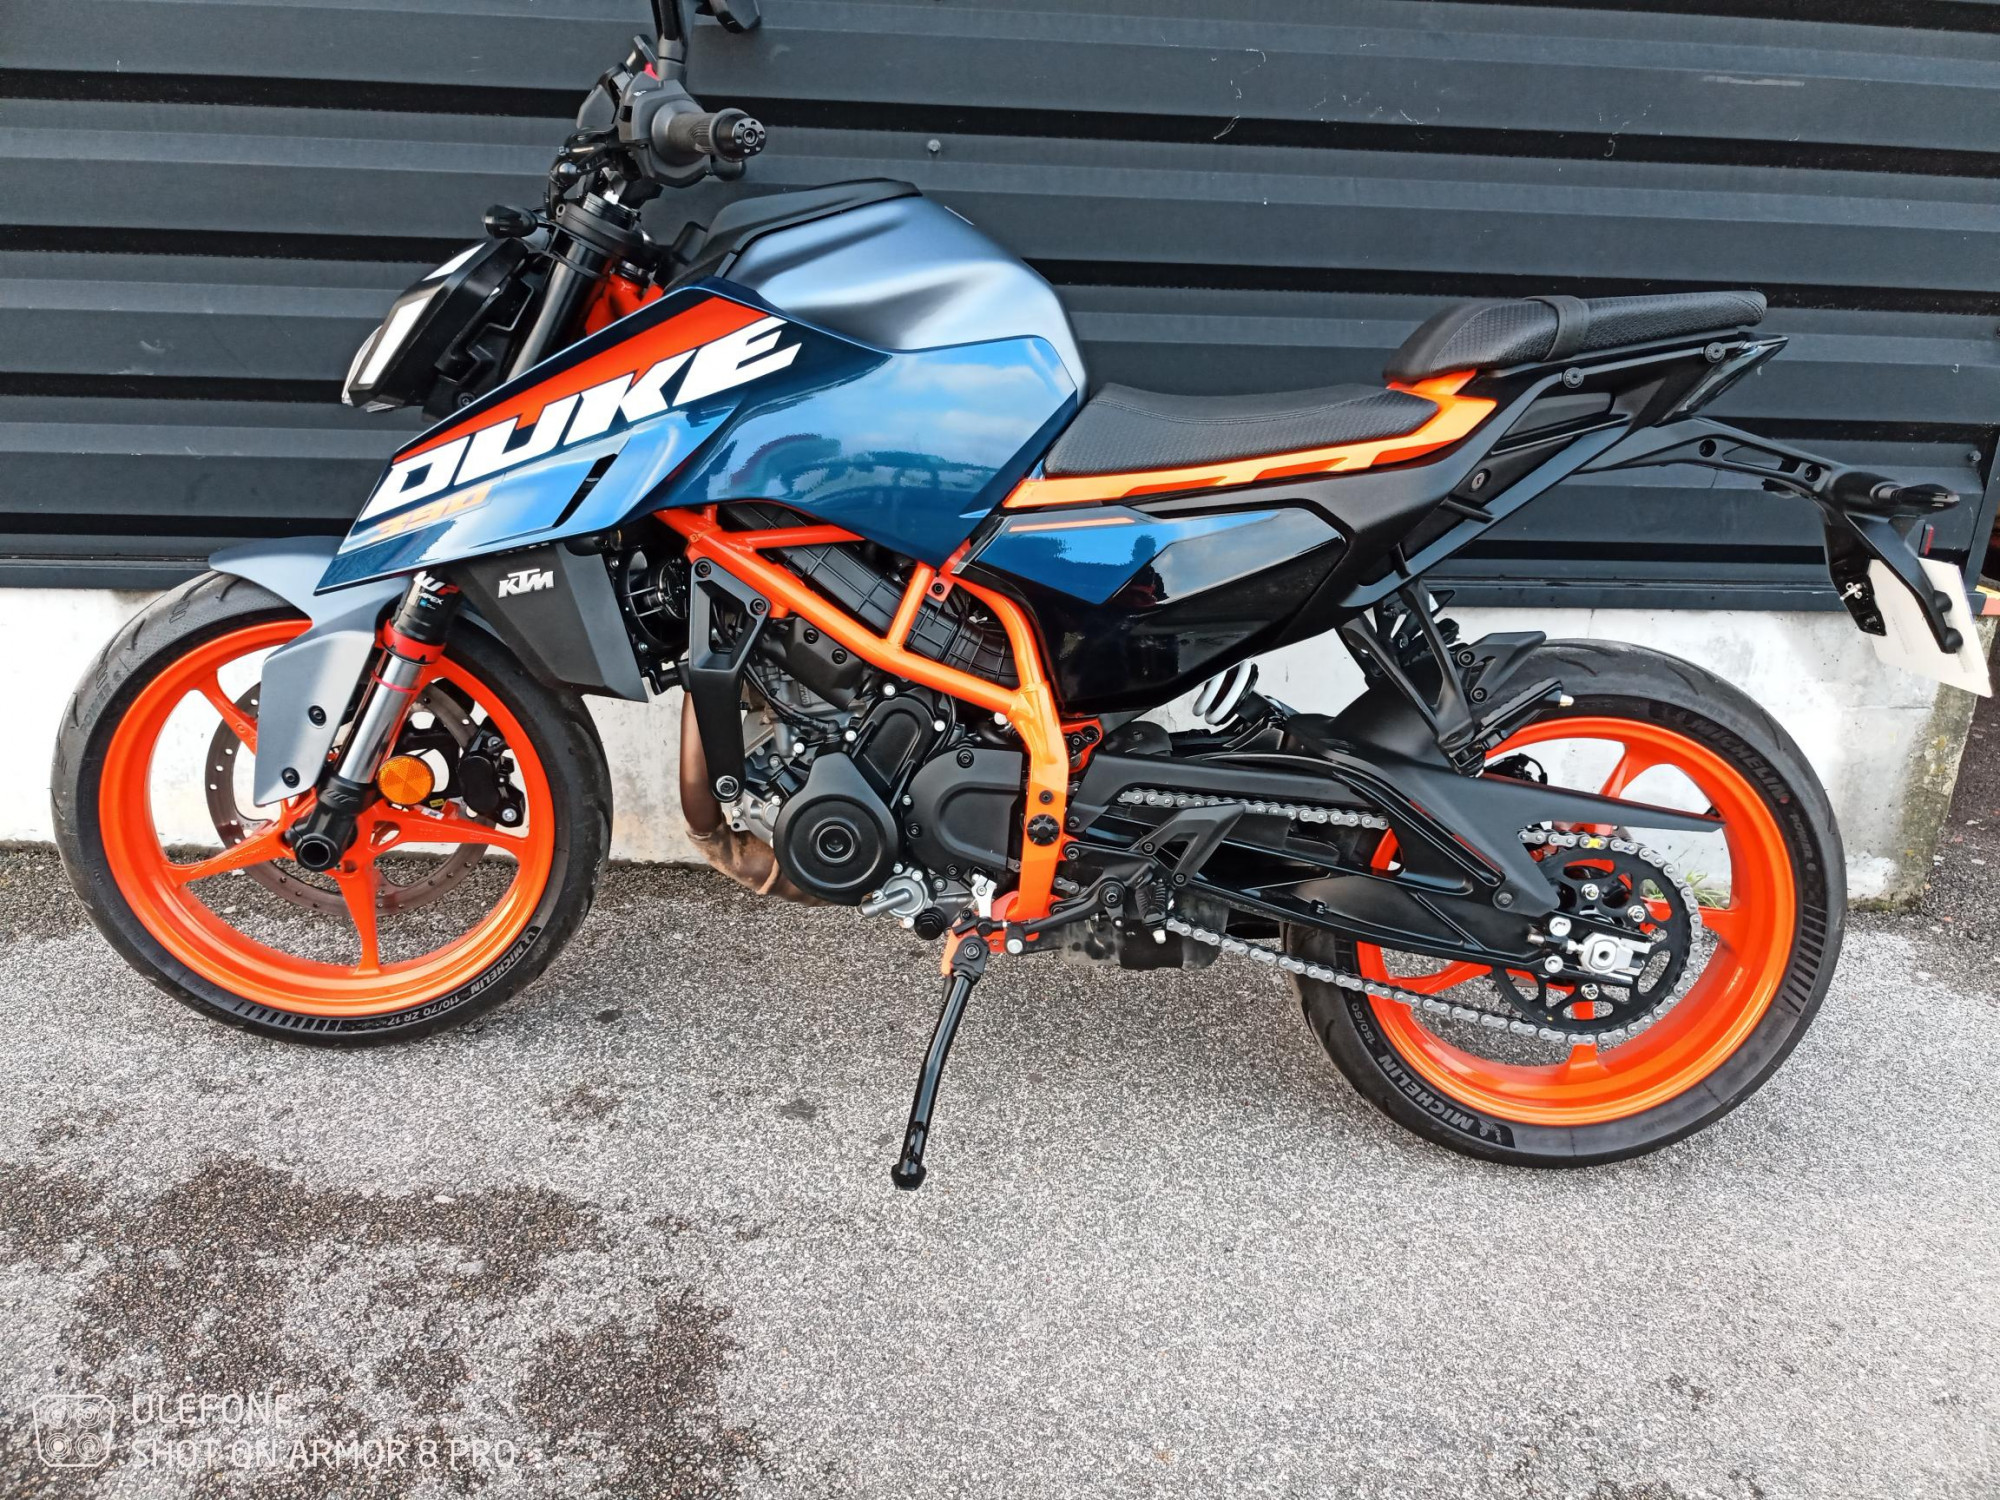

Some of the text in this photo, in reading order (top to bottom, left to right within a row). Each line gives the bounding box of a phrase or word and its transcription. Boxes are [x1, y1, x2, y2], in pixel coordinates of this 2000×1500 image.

[359, 315, 802, 523] DUKE
[498, 568, 554, 598] KTM
[1687, 719, 1789, 802] MICHELIN
[1788, 813, 1814, 860] POWER
[471, 944, 525, 993] MICHELIN
[386, 1015, 401, 1026] 17
[404, 1011, 420, 1023] ZR
[423, 995, 461, 1017] 110/70
[1350, 1003, 1475, 1132] MICHELIN 150/60
